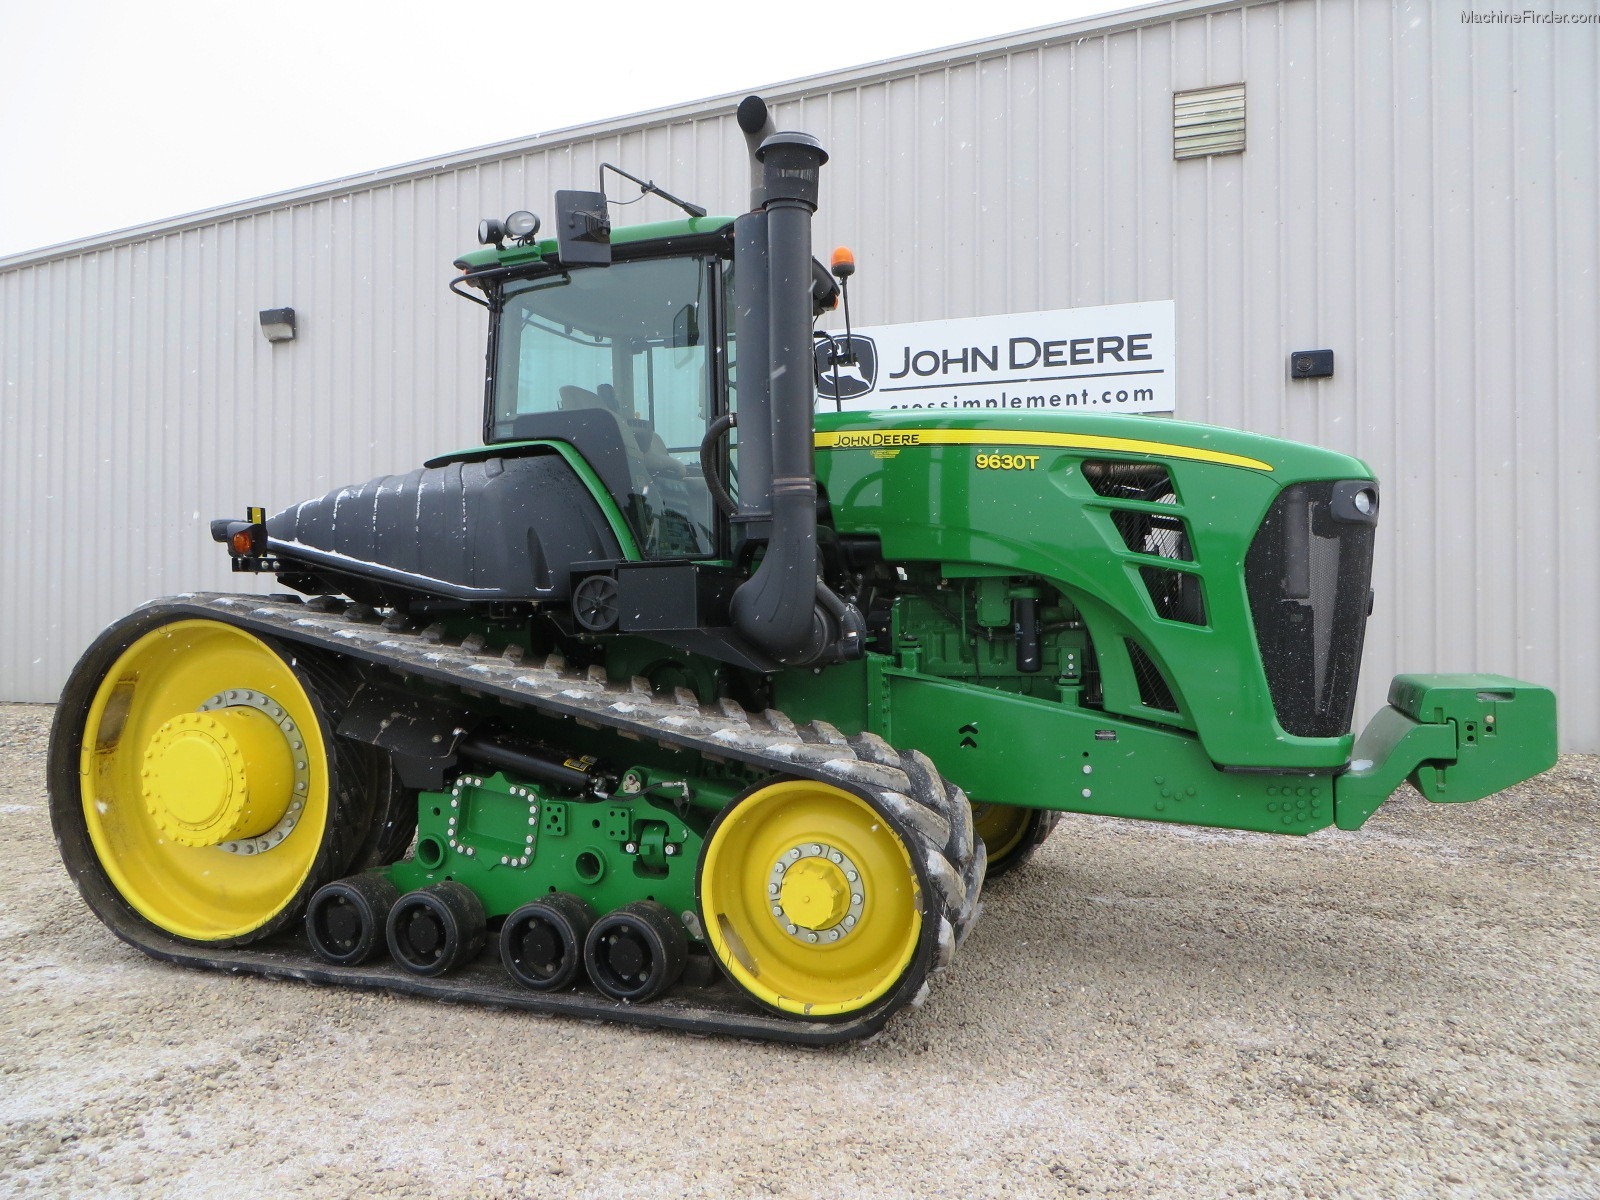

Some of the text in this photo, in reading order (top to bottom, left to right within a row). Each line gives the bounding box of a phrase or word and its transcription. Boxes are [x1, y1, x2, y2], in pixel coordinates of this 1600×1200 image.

[889, 333, 1153, 379] JOHN DEERE
[833, 433, 920, 446] JOHN DEERE
[975, 453, 1040, 470] 9630T
